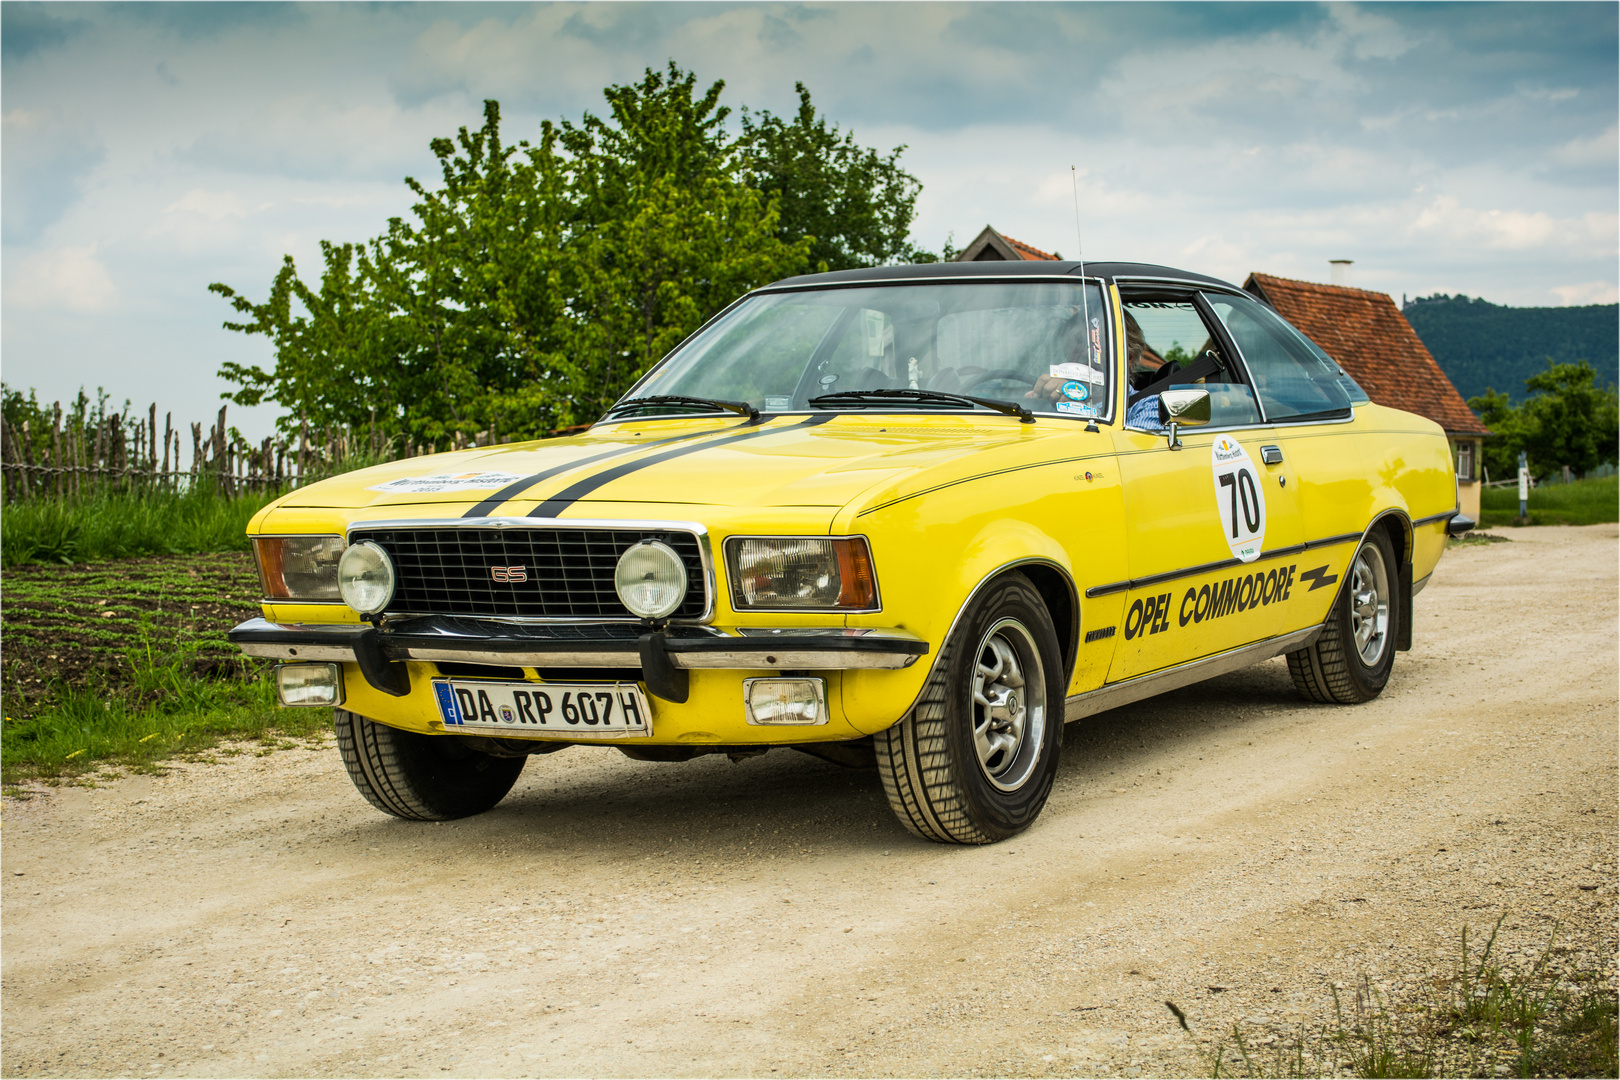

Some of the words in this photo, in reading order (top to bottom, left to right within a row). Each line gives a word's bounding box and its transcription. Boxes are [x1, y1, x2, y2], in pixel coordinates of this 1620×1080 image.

[1218, 468, 1260, 539] 70
[491, 566, 527, 582] GS
[1124, 592, 1172, 641] OPEL
[1179, 564, 1297, 628] COMMODORE
[455, 688, 498, 722] DA
[513, 690, 553, 725] RP
